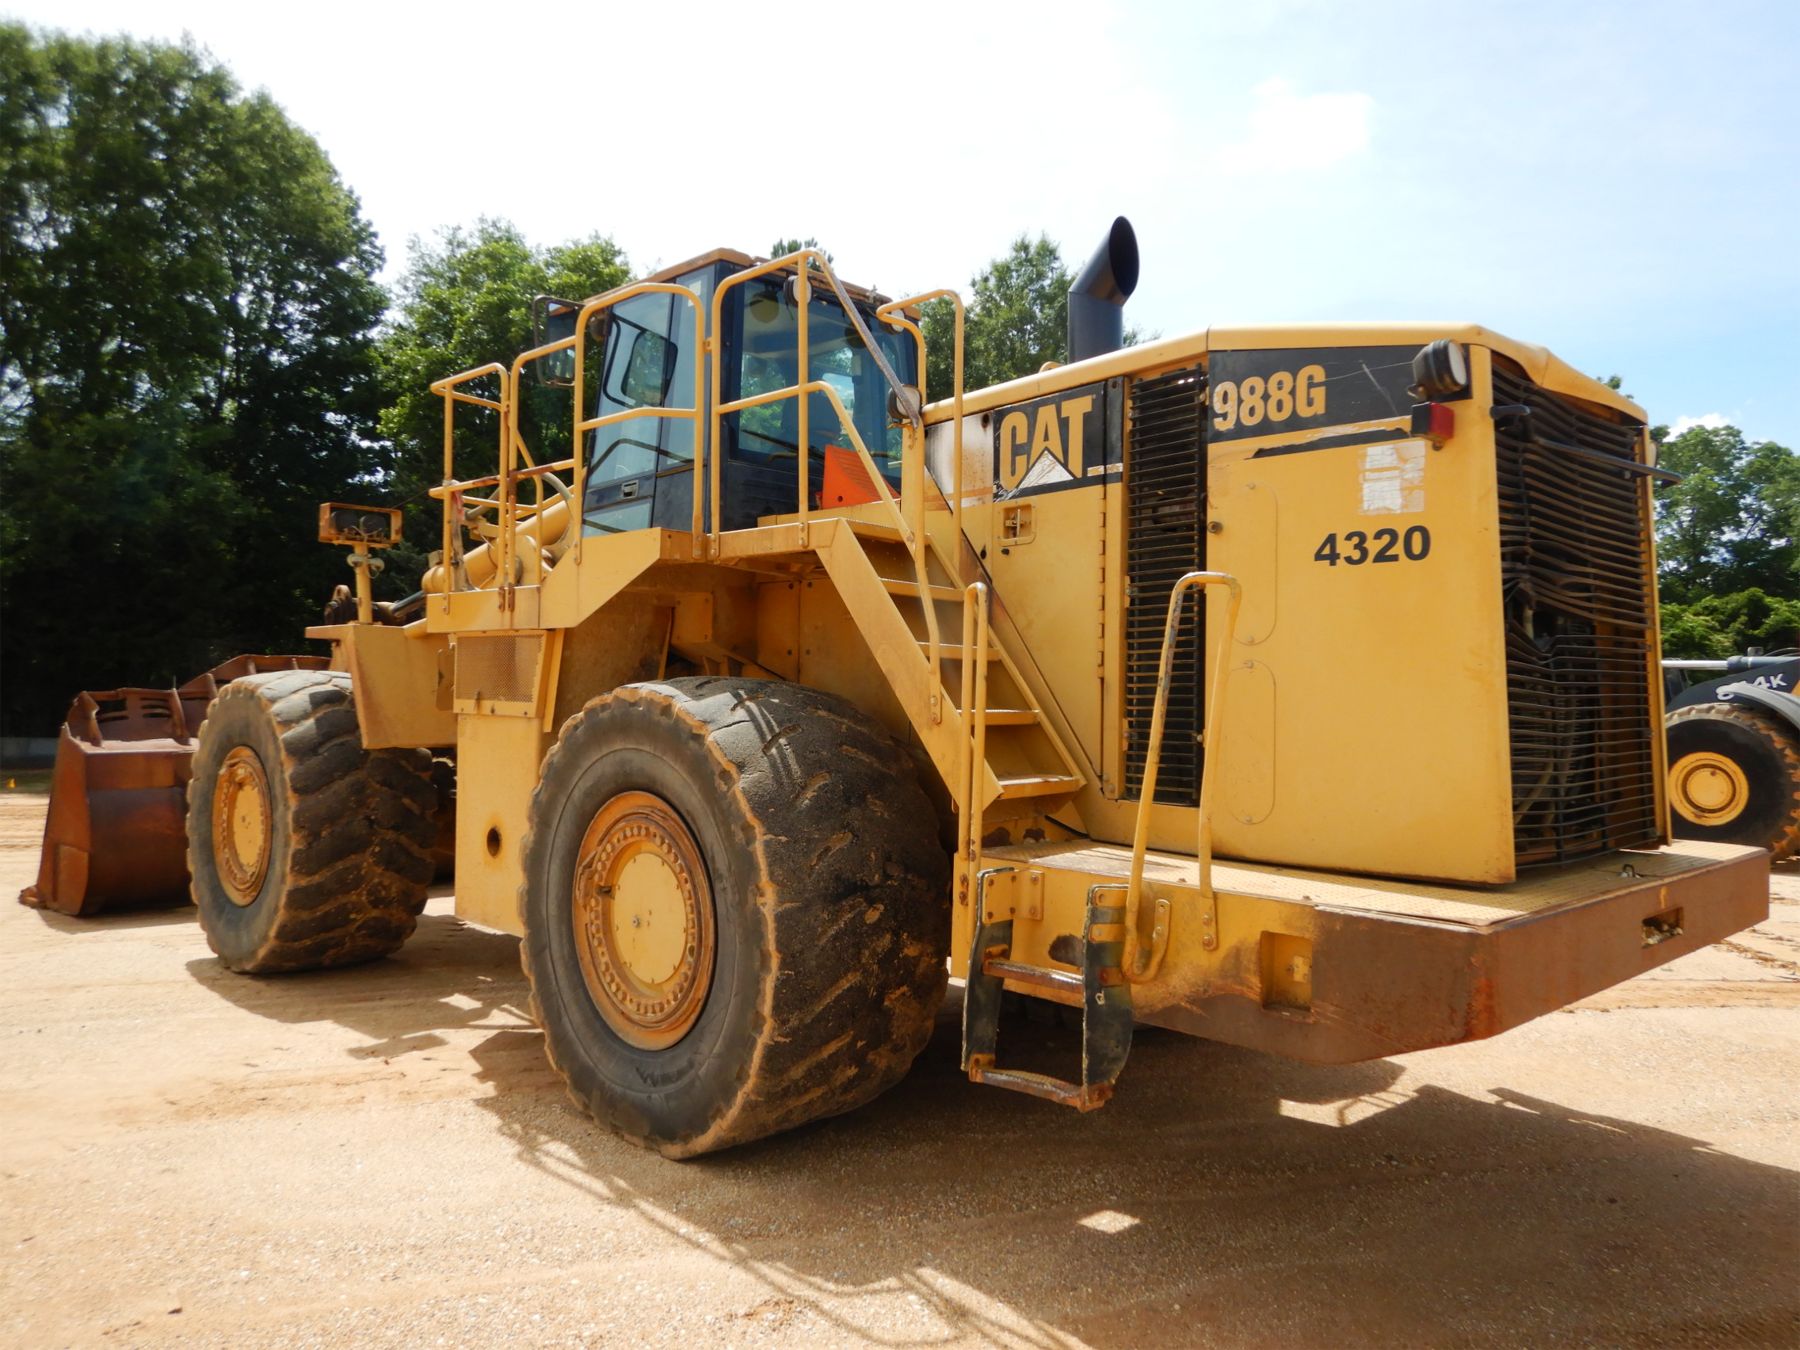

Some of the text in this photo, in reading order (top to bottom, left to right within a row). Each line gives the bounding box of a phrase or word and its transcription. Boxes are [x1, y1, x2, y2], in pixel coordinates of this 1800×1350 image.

[1213, 364, 1326, 432] 988G
[1000, 394, 1093, 493] CAT
[1314, 524, 1431, 567] 4320
